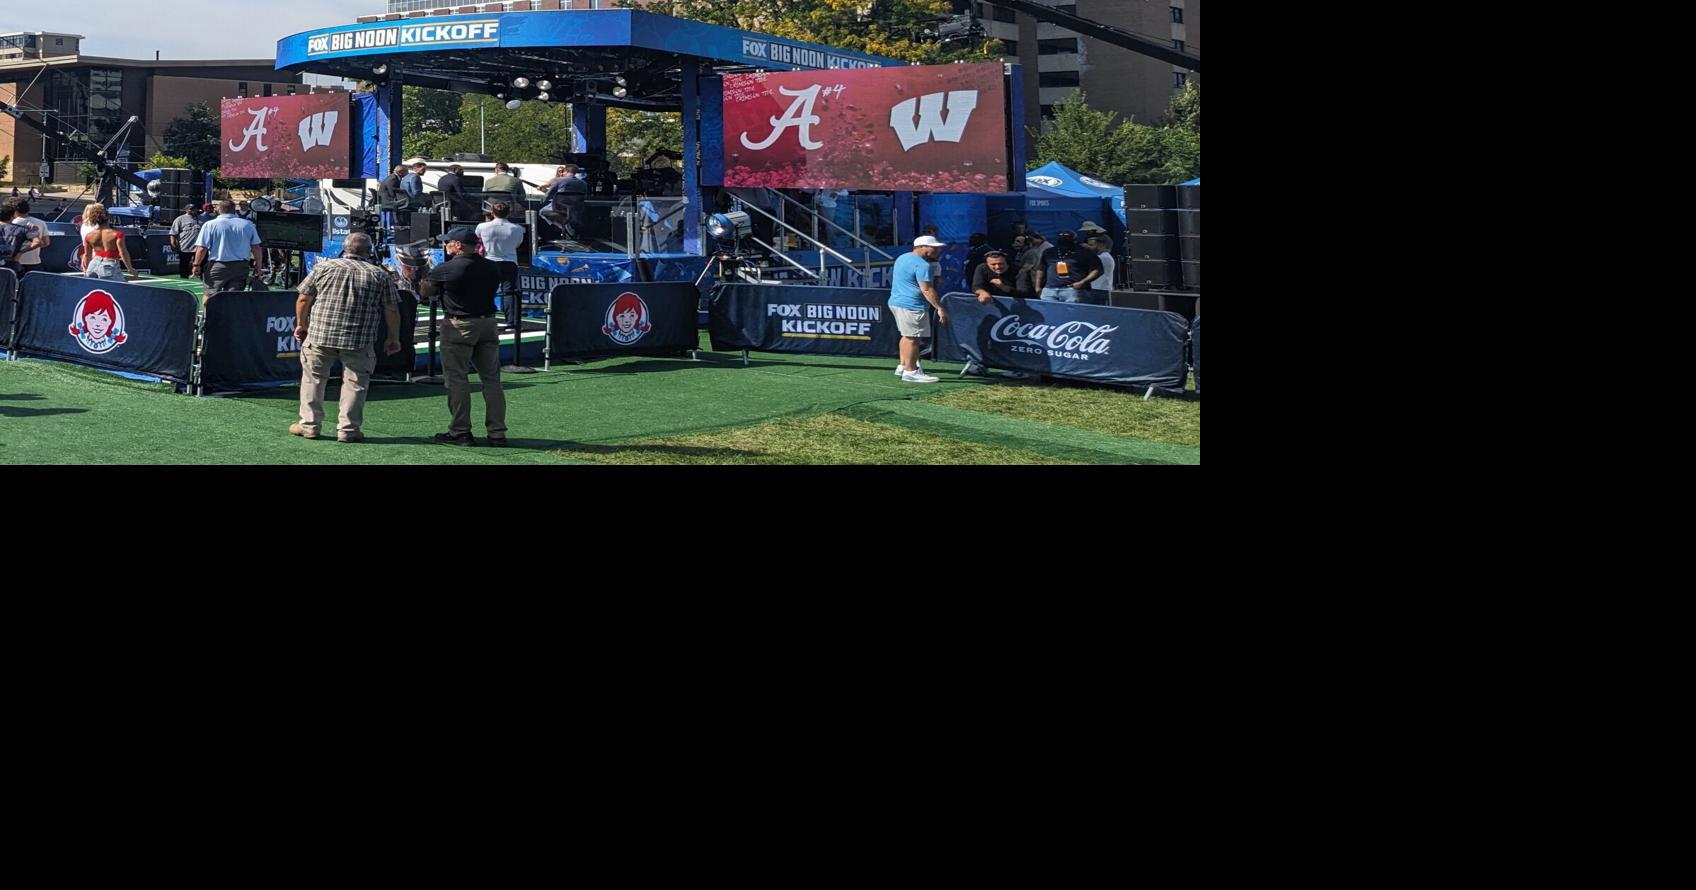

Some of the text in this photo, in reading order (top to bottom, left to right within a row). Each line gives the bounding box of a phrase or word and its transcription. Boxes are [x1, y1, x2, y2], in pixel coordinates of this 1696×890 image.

[308, 23, 499, 53] FOX BIG NOON KICKOFF
[742, 39, 767, 58] FOX
[770, 43, 790, 63] BIG
[793, 47, 825, 68] NOON
[821, 84, 846, 100] #4
[228, 106, 269, 152] A
[298, 110, 338, 152] W
[740, 84, 824, 151] A
[889, 89, 978, 152] W
[521, 275, 546, 290] BIG
[767, 303, 880, 321] FOX BIG NOON
[781, 319, 872, 335] KICKOFF
[990, 314, 1119, 355] Coca-Cola
[1010, 345, 1089, 361] ZERO SUGAR
